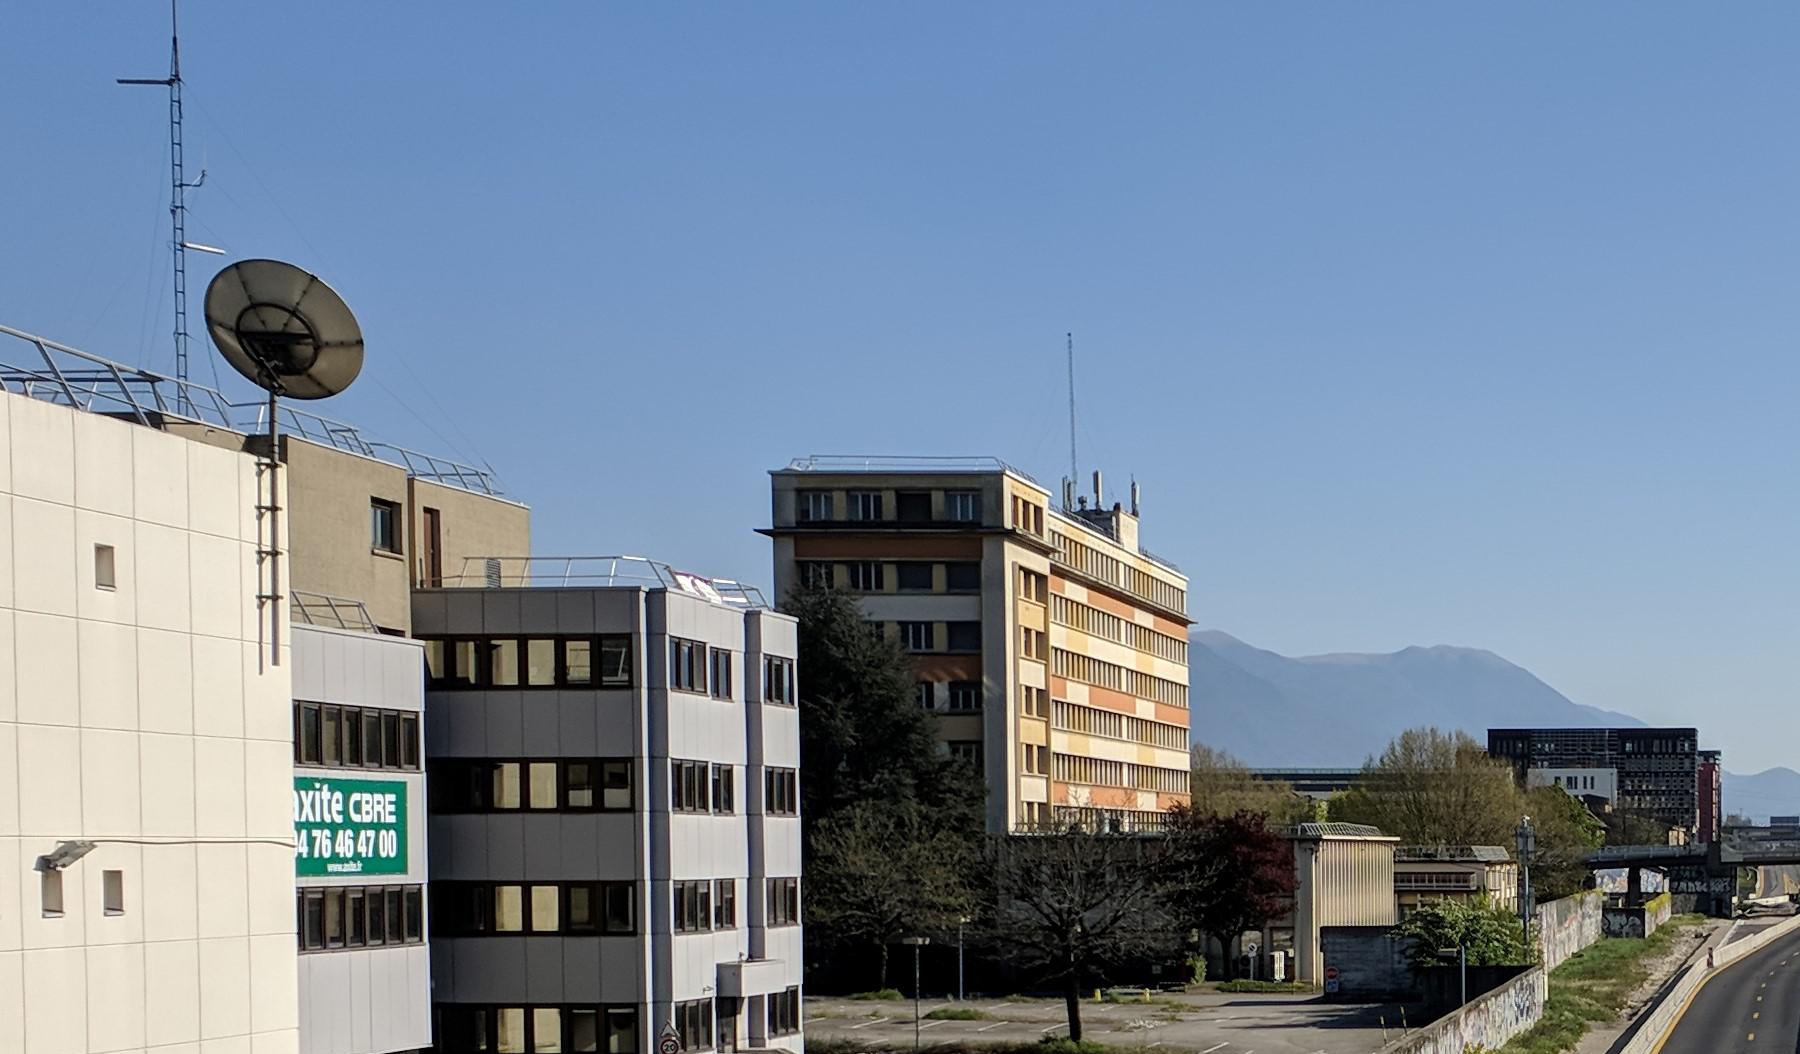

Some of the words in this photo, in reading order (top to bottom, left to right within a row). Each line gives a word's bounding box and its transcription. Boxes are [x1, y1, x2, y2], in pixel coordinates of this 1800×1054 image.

[349, 792, 397, 823] CBRE
[312, 829, 332, 858] 76
[335, 829, 354, 858] 46
[357, 829, 376, 858] 47
[379, 829, 397, 858] 00
